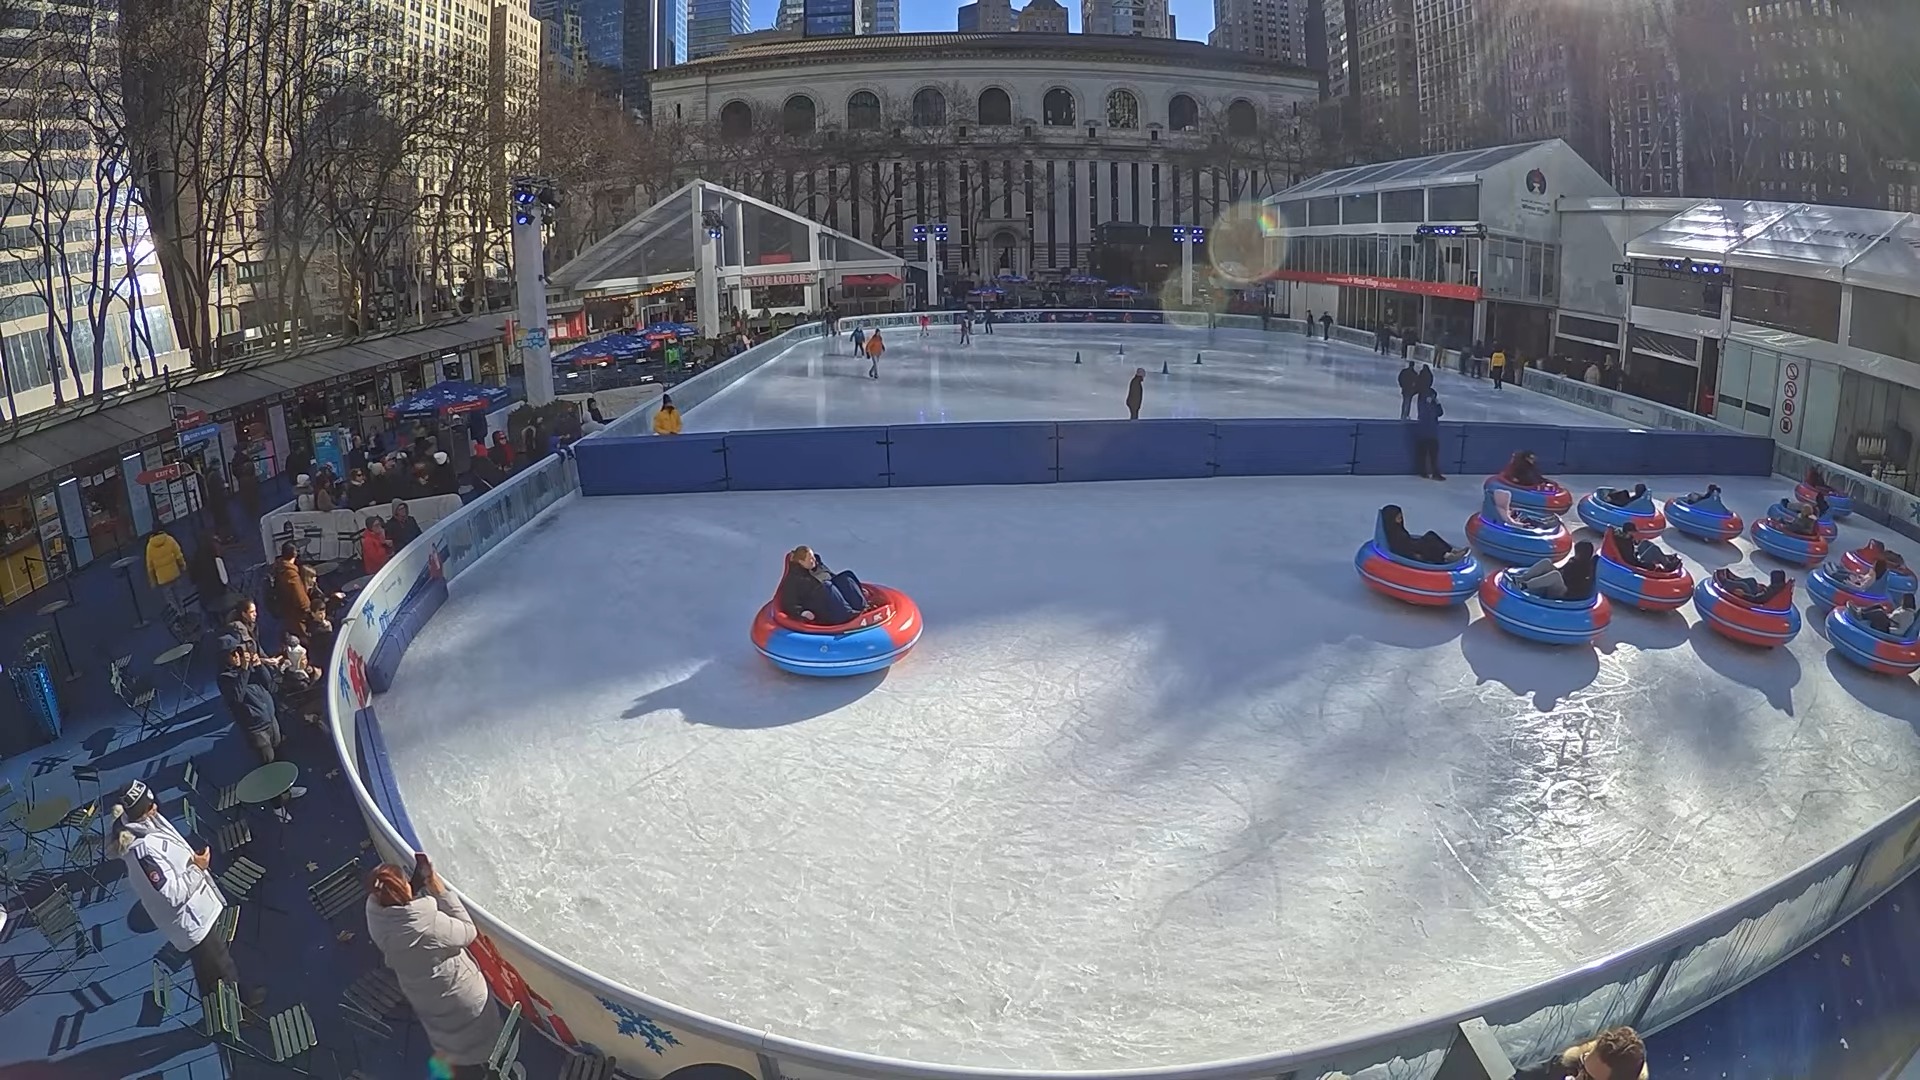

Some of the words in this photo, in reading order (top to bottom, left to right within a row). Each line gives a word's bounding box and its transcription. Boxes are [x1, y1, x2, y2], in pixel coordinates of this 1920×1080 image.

[1808, 228, 1892, 243] MERICA
[752, 275, 772, 286] THE
[773, 273, 806, 285] LODGE
[155, 470, 168, 478] EXIT
